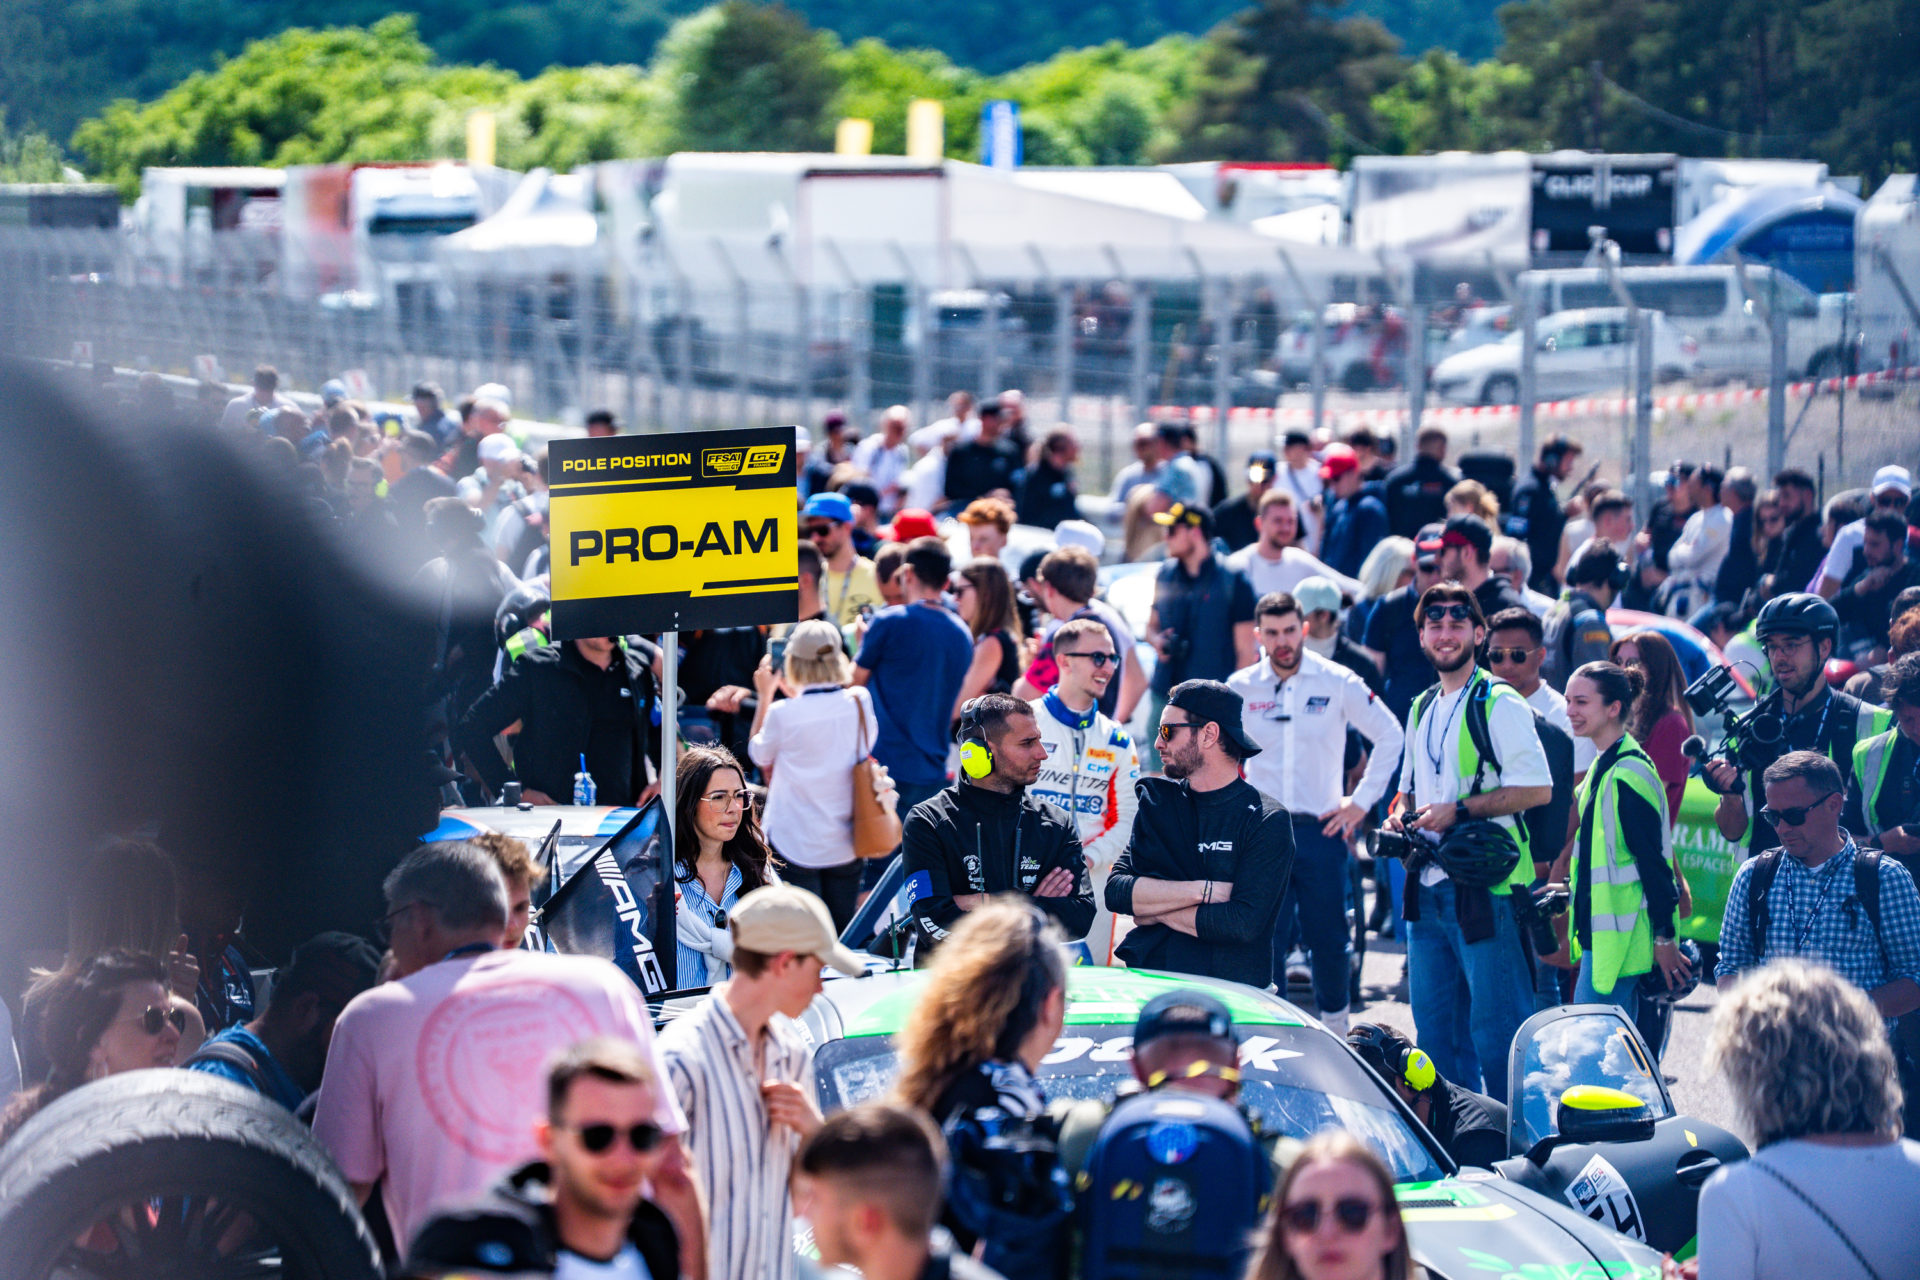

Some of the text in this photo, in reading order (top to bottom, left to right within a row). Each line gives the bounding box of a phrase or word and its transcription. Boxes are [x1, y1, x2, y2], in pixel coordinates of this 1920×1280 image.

[562, 452, 691, 472] POLE POSITION
[570, 518, 779, 566] PRO-AM
[602, 879, 668, 994] AMG
